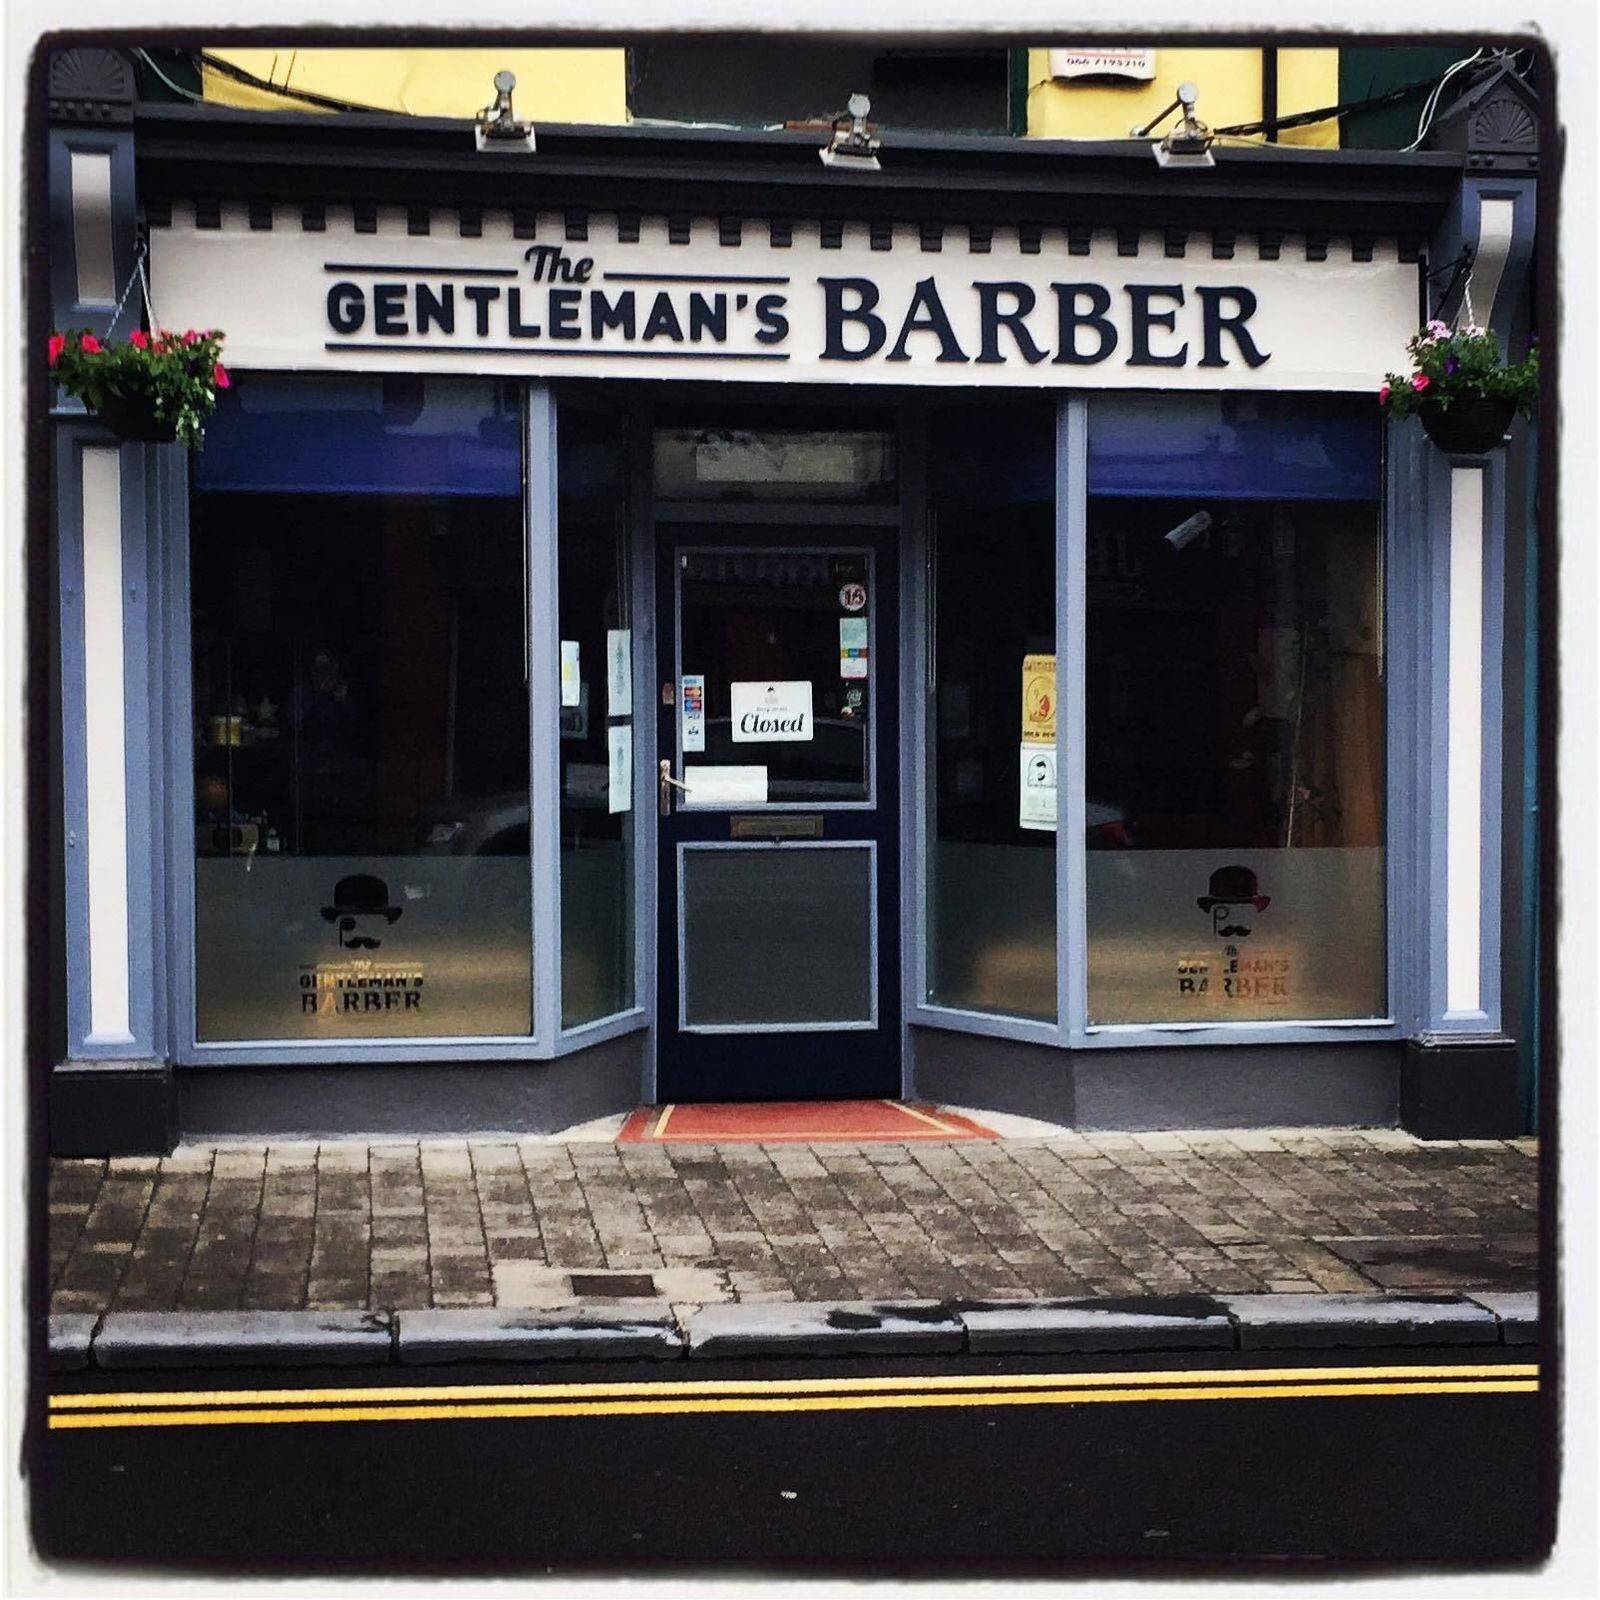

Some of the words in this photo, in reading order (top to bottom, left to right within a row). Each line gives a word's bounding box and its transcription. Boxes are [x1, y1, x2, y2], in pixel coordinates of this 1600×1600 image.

[524, 245, 594, 283] The
[326, 281, 790, 344] GENTLEMAN'S
[817, 276, 1272, 368] BARBER
[741, 713, 805, 734] Closed
